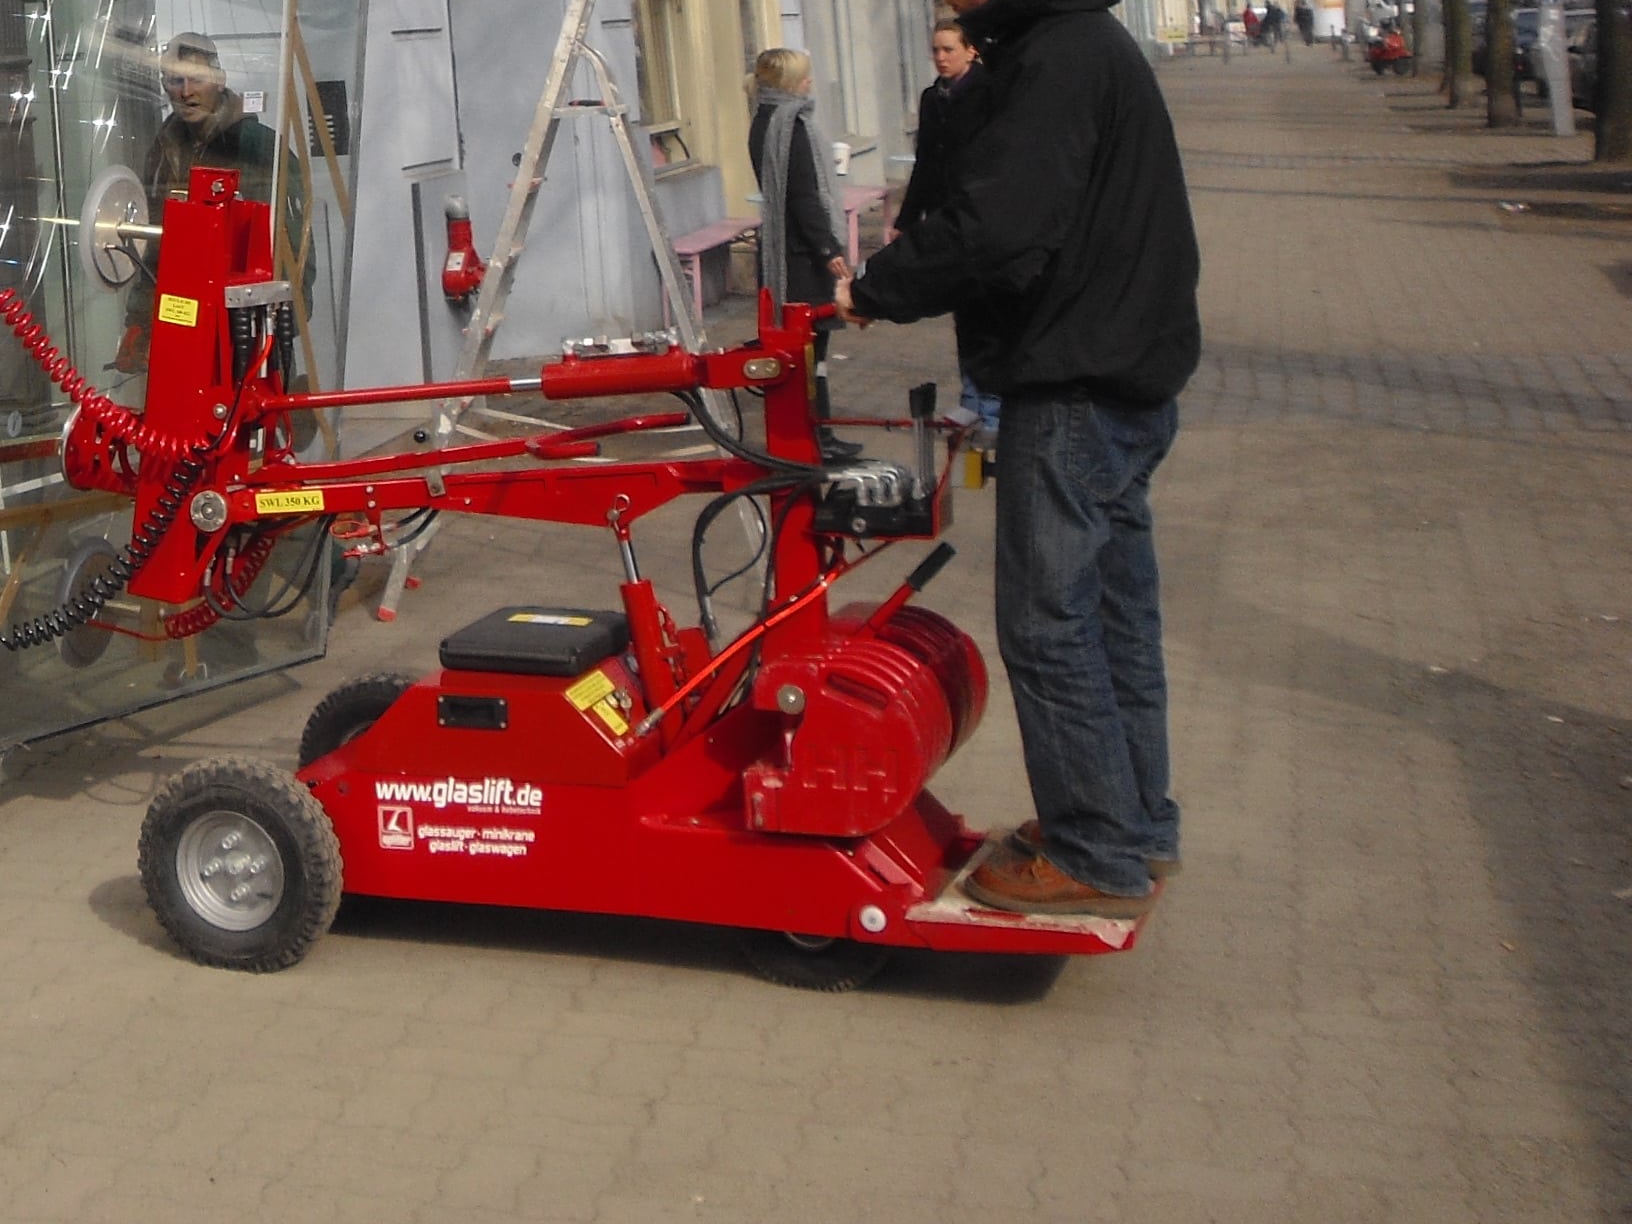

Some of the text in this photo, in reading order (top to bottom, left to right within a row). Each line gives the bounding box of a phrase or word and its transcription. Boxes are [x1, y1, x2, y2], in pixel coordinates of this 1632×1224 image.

[259, 498, 283, 508] SWL
[303, 495, 320, 506] KG
[375, 777, 542, 808] www.glaslift.de
[418, 825, 475, 840] glassauger
[430, 840, 527, 857] glaslift glaswagen
